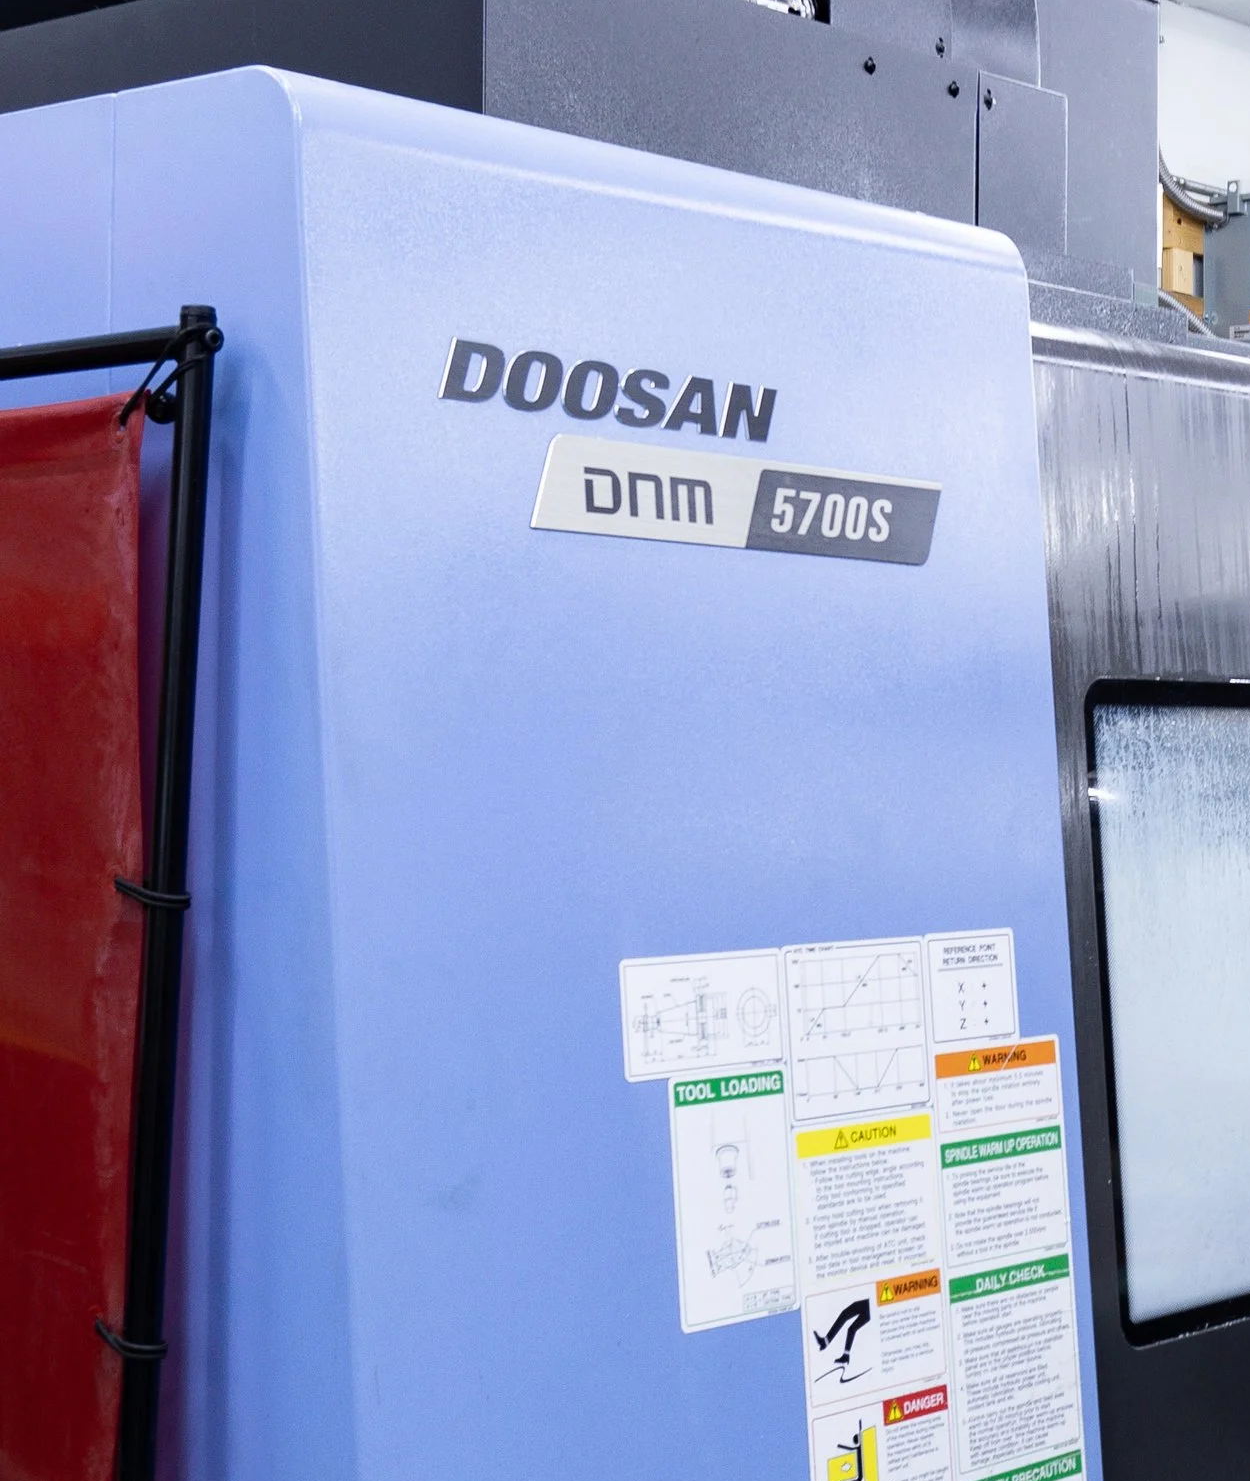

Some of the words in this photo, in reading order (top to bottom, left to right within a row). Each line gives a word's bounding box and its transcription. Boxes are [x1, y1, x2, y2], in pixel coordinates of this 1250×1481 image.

[437, 336, 778, 442] DOOSAN
[770, 487, 892, 543] 5700S
[982, 1049, 1026, 1066] WARNING
[676, 1083, 715, 1103] TOOL
[721, 1074, 781, 1099] LOADING
[850, 1124, 897, 1143] CAUTION
[944, 1143, 978, 1162] SPINDLE
[979, 1139, 1003, 1157] WARM
[1003, 1138, 1015, 1153] UP
[1015, 1131, 1059, 1151] OPERATION
[893, 1275, 939, 1296] WARNING
[975, 1272, 1006, 1293] DAILY
[1008, 1263, 1045, 1284] CHECK
[903, 1392, 944, 1415] DANGER
